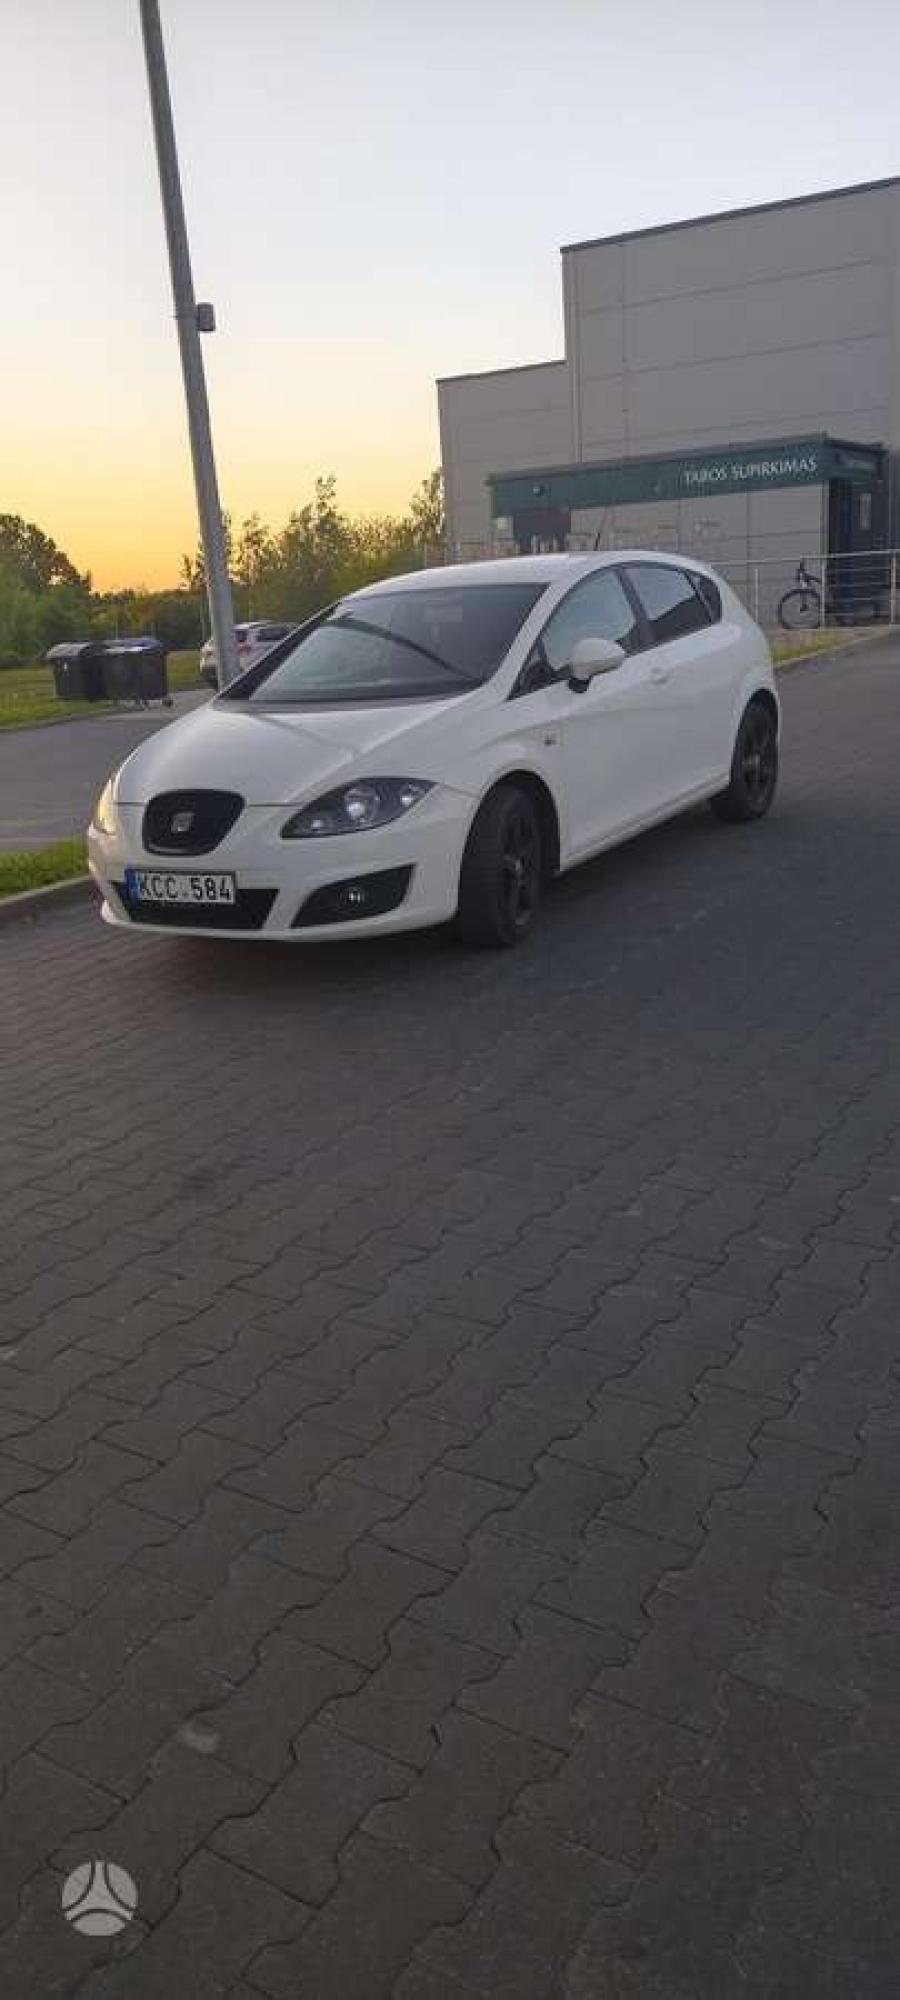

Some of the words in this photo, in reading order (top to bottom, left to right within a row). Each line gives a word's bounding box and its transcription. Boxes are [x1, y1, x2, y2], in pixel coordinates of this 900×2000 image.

[731, 458, 817, 478] SUPIRKIMAS
[138, 874, 178, 899] KCC
[190, 877, 230, 900] 584
